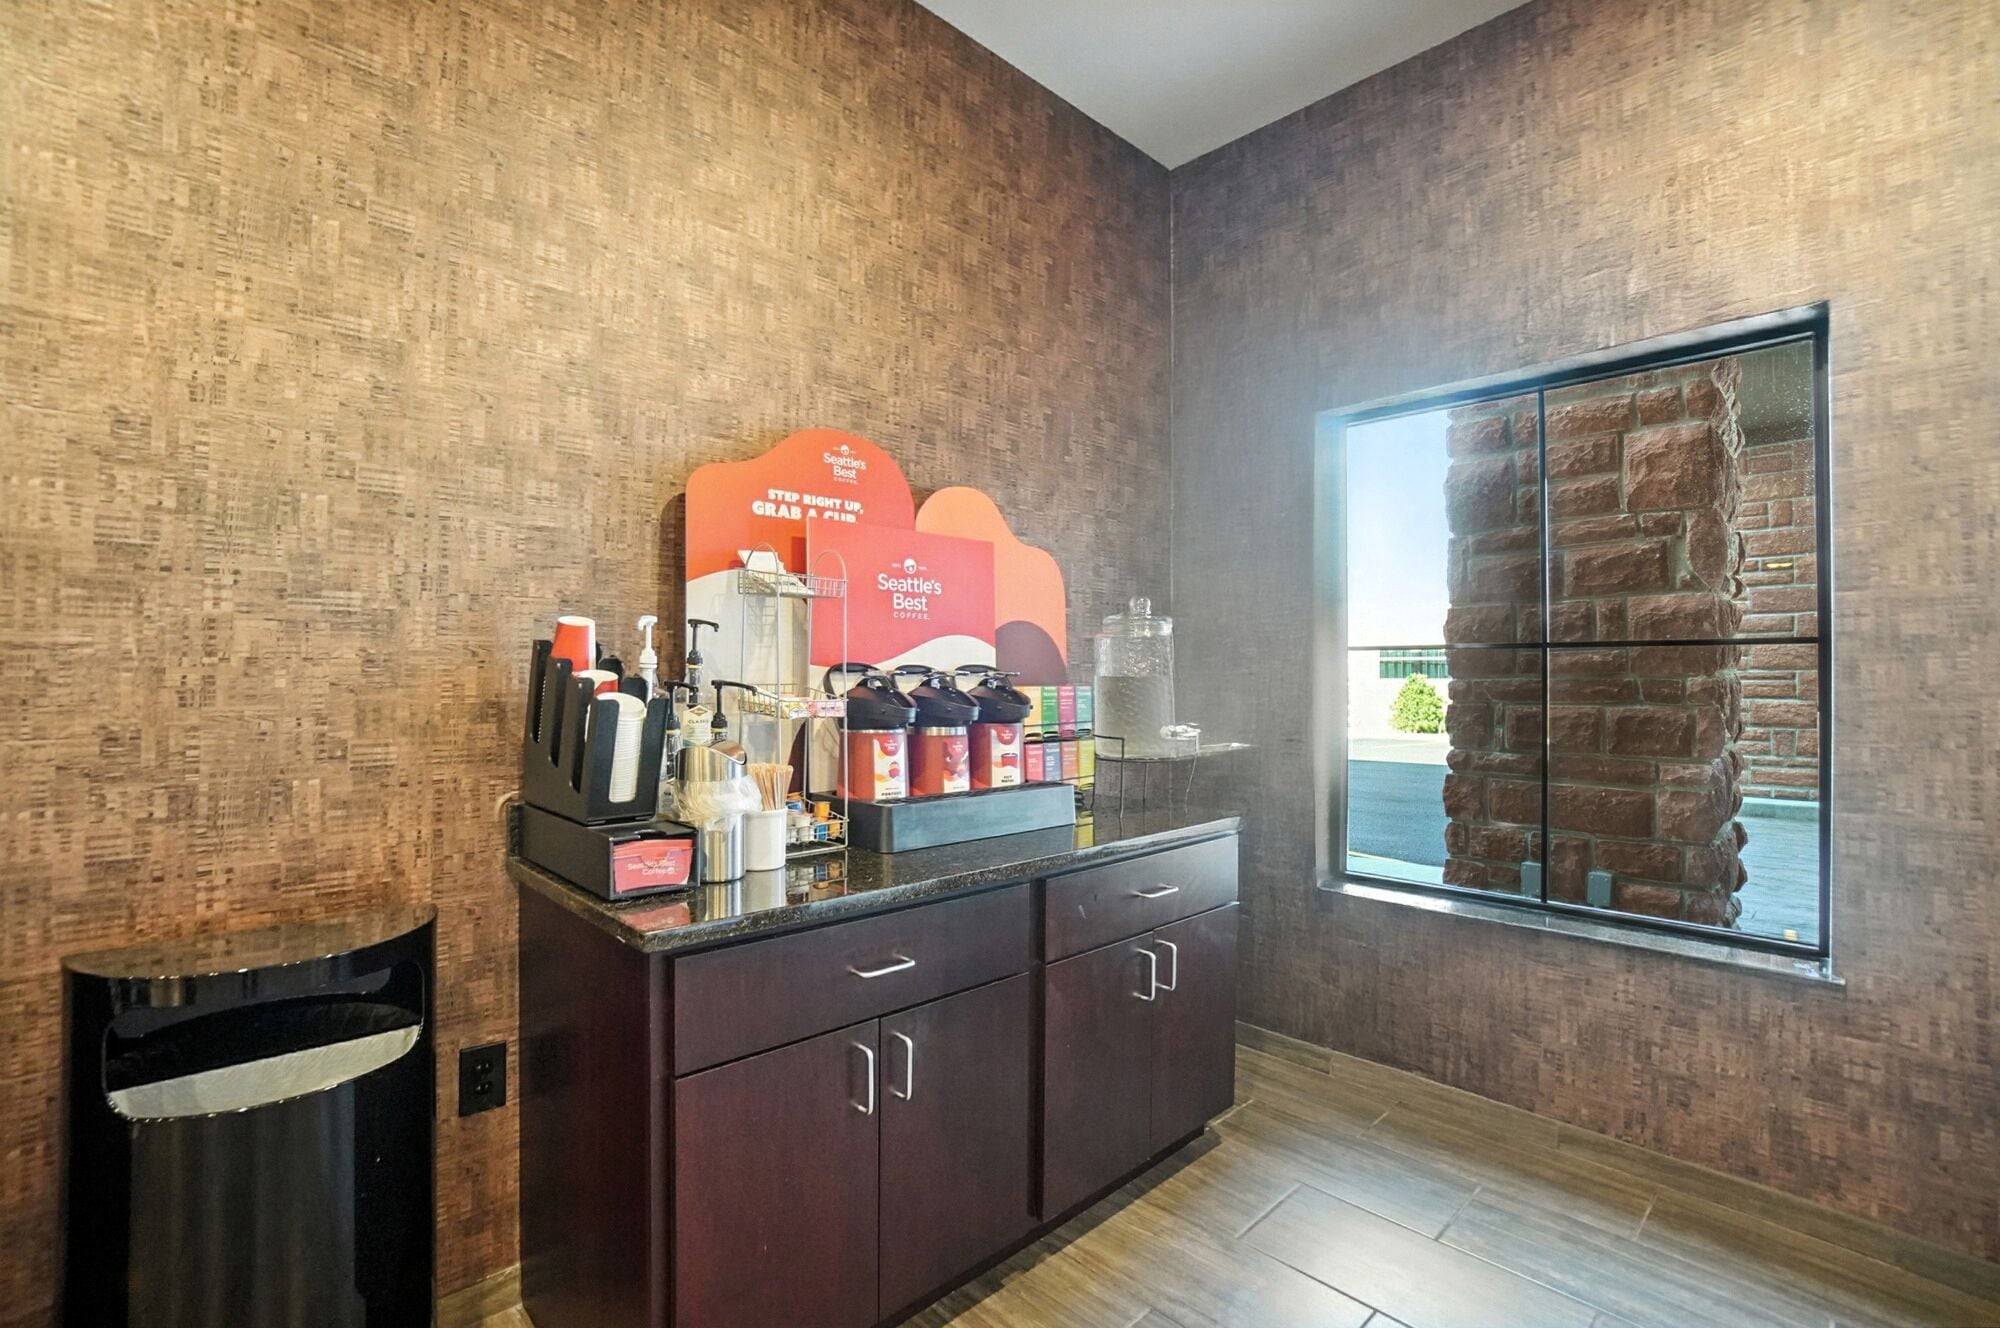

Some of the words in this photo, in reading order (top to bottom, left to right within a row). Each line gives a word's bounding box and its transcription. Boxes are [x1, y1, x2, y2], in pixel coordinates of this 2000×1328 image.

[823, 452, 867, 470] Seattle's
[833, 465, 857, 479] Best
[767, 488, 800, 503] STEP
[803, 494, 842, 510] RIGHT
[752, 500, 802, 520] GRAB
[808, 508, 818, 518] A
[877, 573, 942, 595] Seattle's
[893, 592, 928, 611] Best
